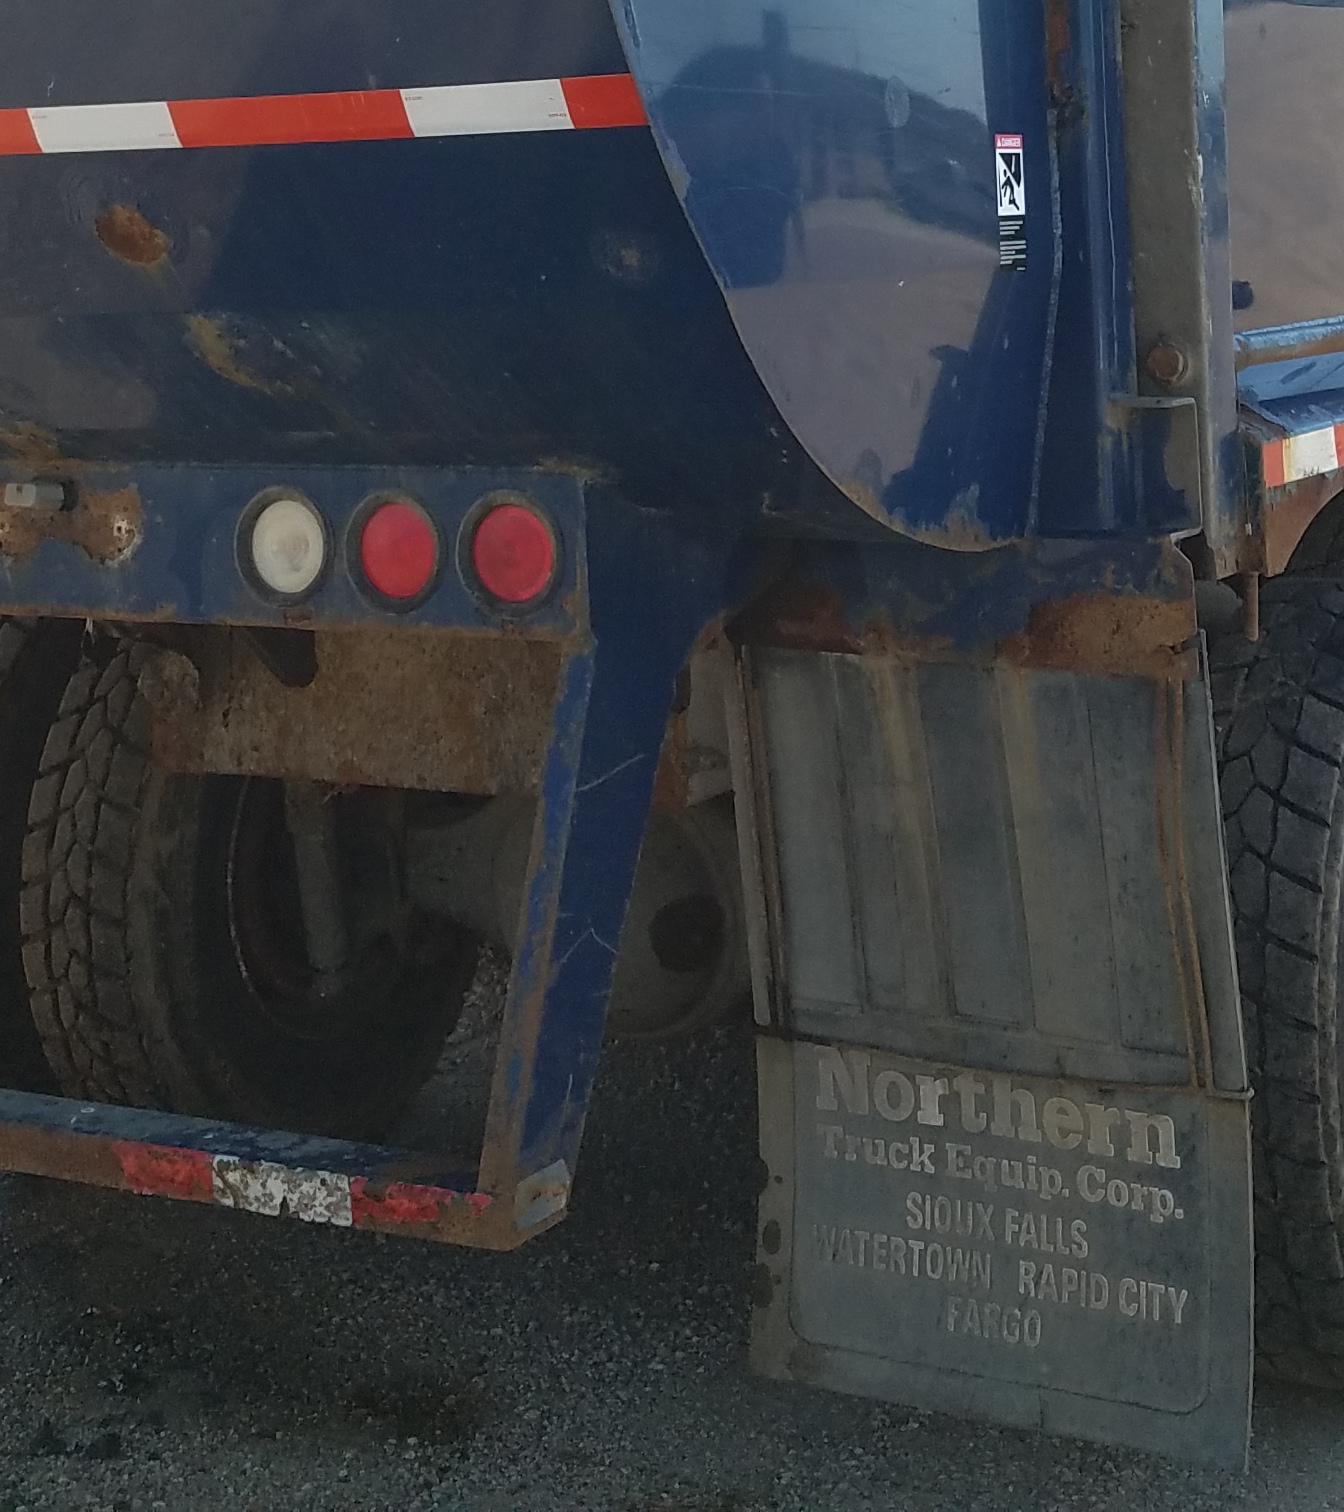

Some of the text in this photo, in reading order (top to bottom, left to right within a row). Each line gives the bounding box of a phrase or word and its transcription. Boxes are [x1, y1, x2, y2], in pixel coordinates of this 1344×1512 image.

[815, 1045, 1182, 1170] Northern
[818, 1125, 1185, 1223] Truck Equip. Corp.
[812, 1224, 1190, 1324] WATERTOWN RAPID CITY
[905, 1191, 1089, 1259] SIOUX FALLS
[946, 1297, 1042, 1348] FARGO
